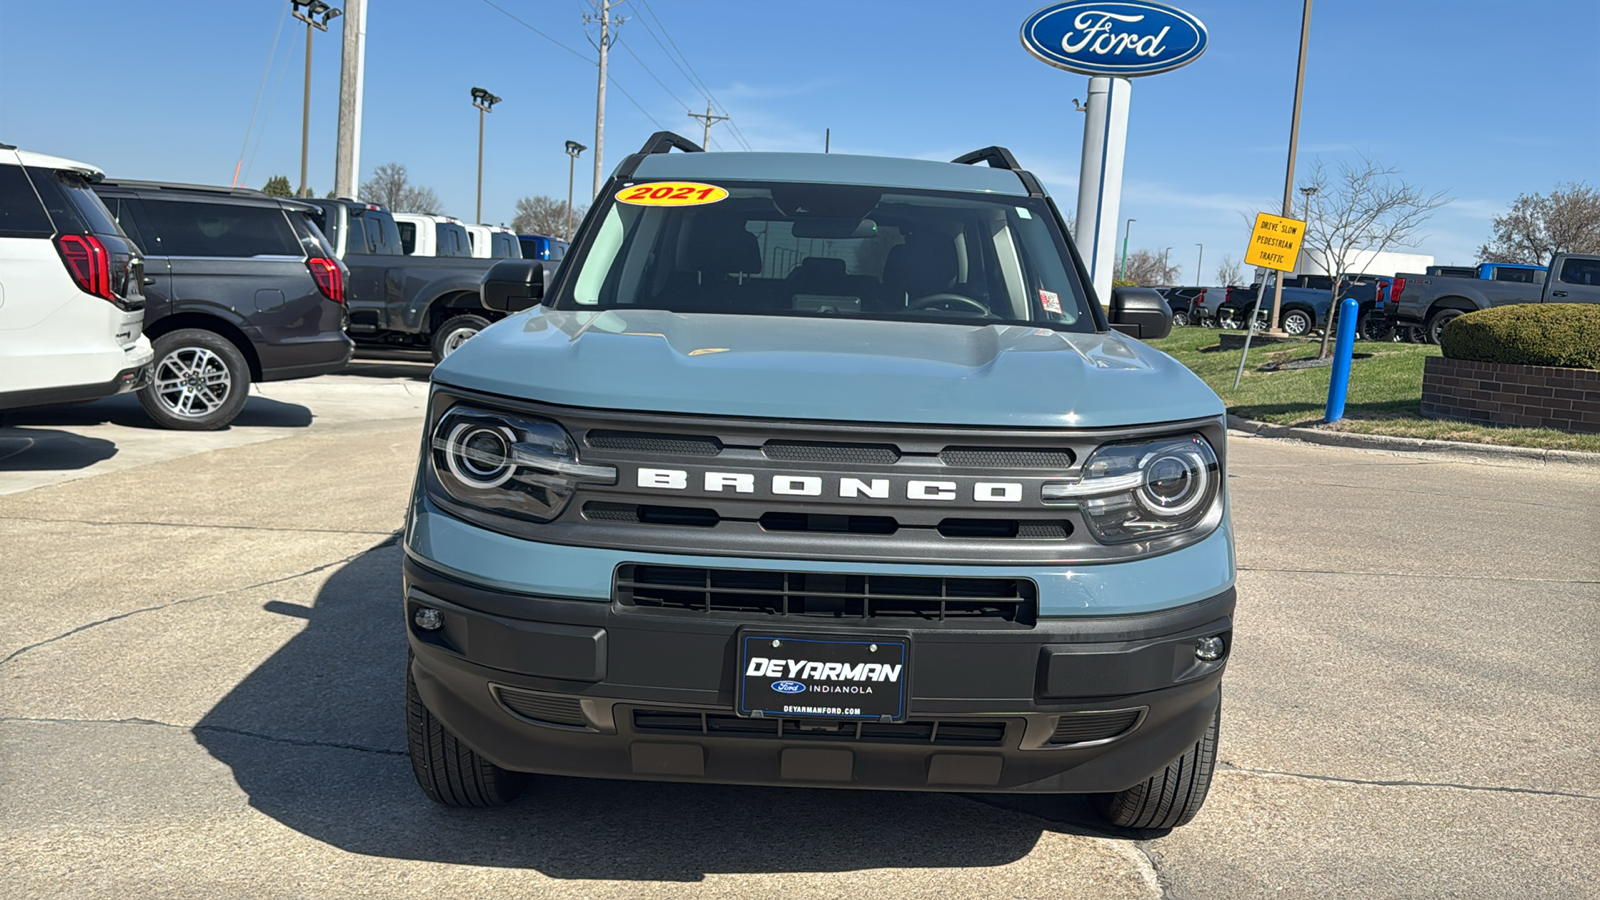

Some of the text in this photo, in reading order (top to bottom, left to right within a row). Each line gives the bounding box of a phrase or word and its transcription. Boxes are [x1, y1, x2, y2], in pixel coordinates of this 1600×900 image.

[1061, 10, 1171, 57] Ford
[625, 186, 716, 200] 2021
[1260, 220, 1298, 235] DRIVE SLOW
[1256, 235, 1294, 250] PEDESTRIAN
[1259, 251, 1285, 264] TRAFFIC
[637, 467, 1023, 502] BRONCO
[745, 657, 903, 683] DEYARMAN
[777, 681, 873, 694] Ford INDIANOLA
[783, 705, 861, 715] DEYARMANFORD.COM
